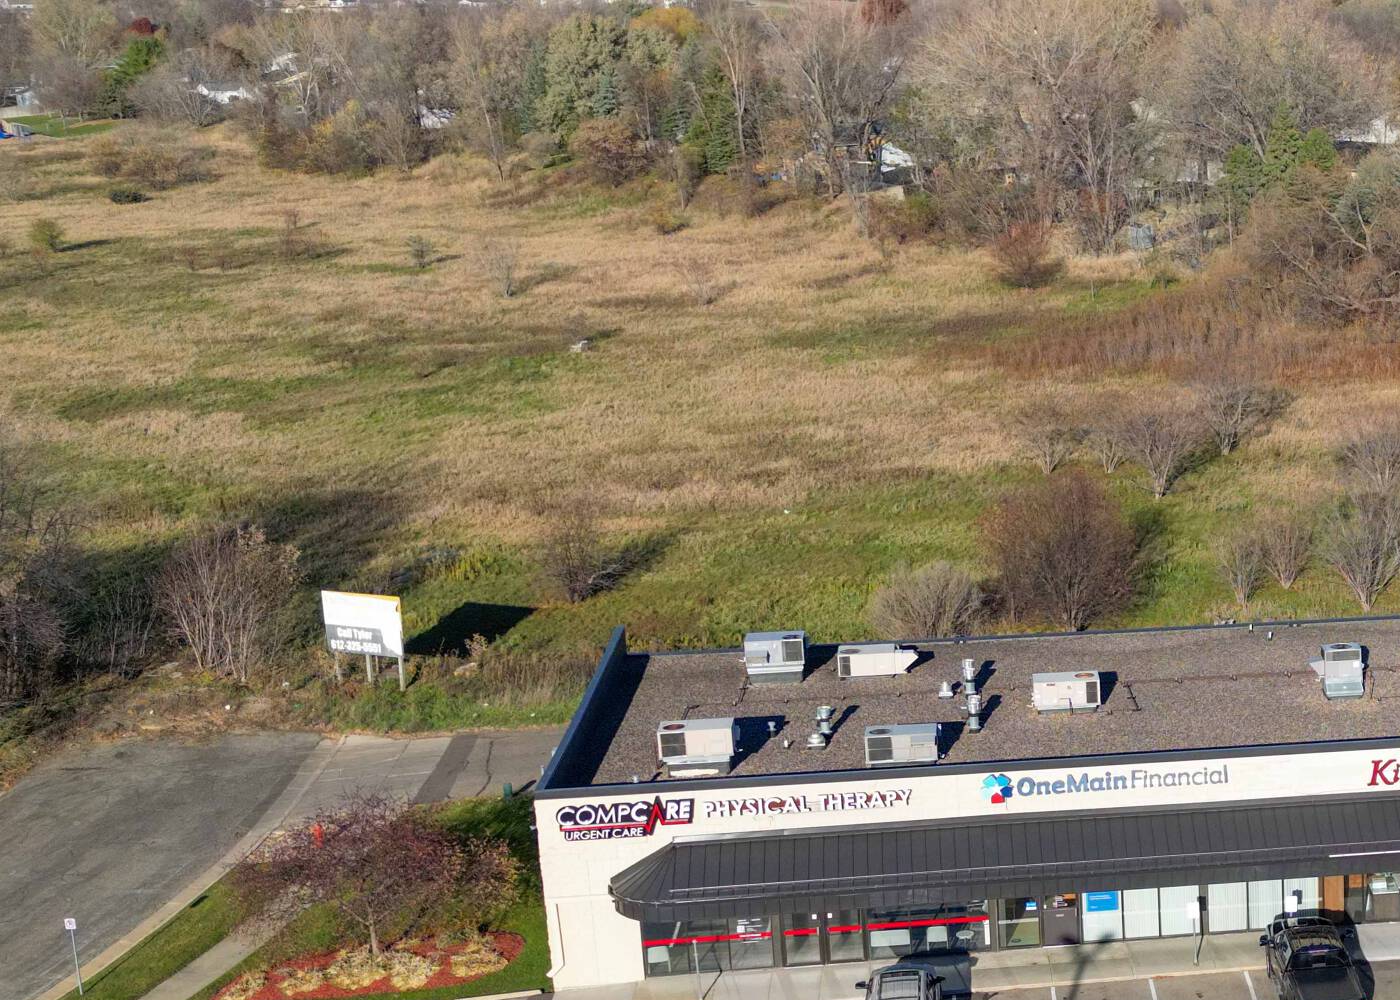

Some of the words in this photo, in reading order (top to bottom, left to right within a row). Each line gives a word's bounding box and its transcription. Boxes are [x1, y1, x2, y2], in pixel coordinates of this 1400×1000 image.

[1017, 771, 1127, 797] OneMain
[1130, 764, 1229, 788] Financial
[557, 798, 692, 827] COMPCARE
[703, 795, 811, 818] PHYSICAL
[818, 789, 913, 811] THERAPY
[565, 829, 610, 840] URGENT
[612, 827, 644, 839] CARE
